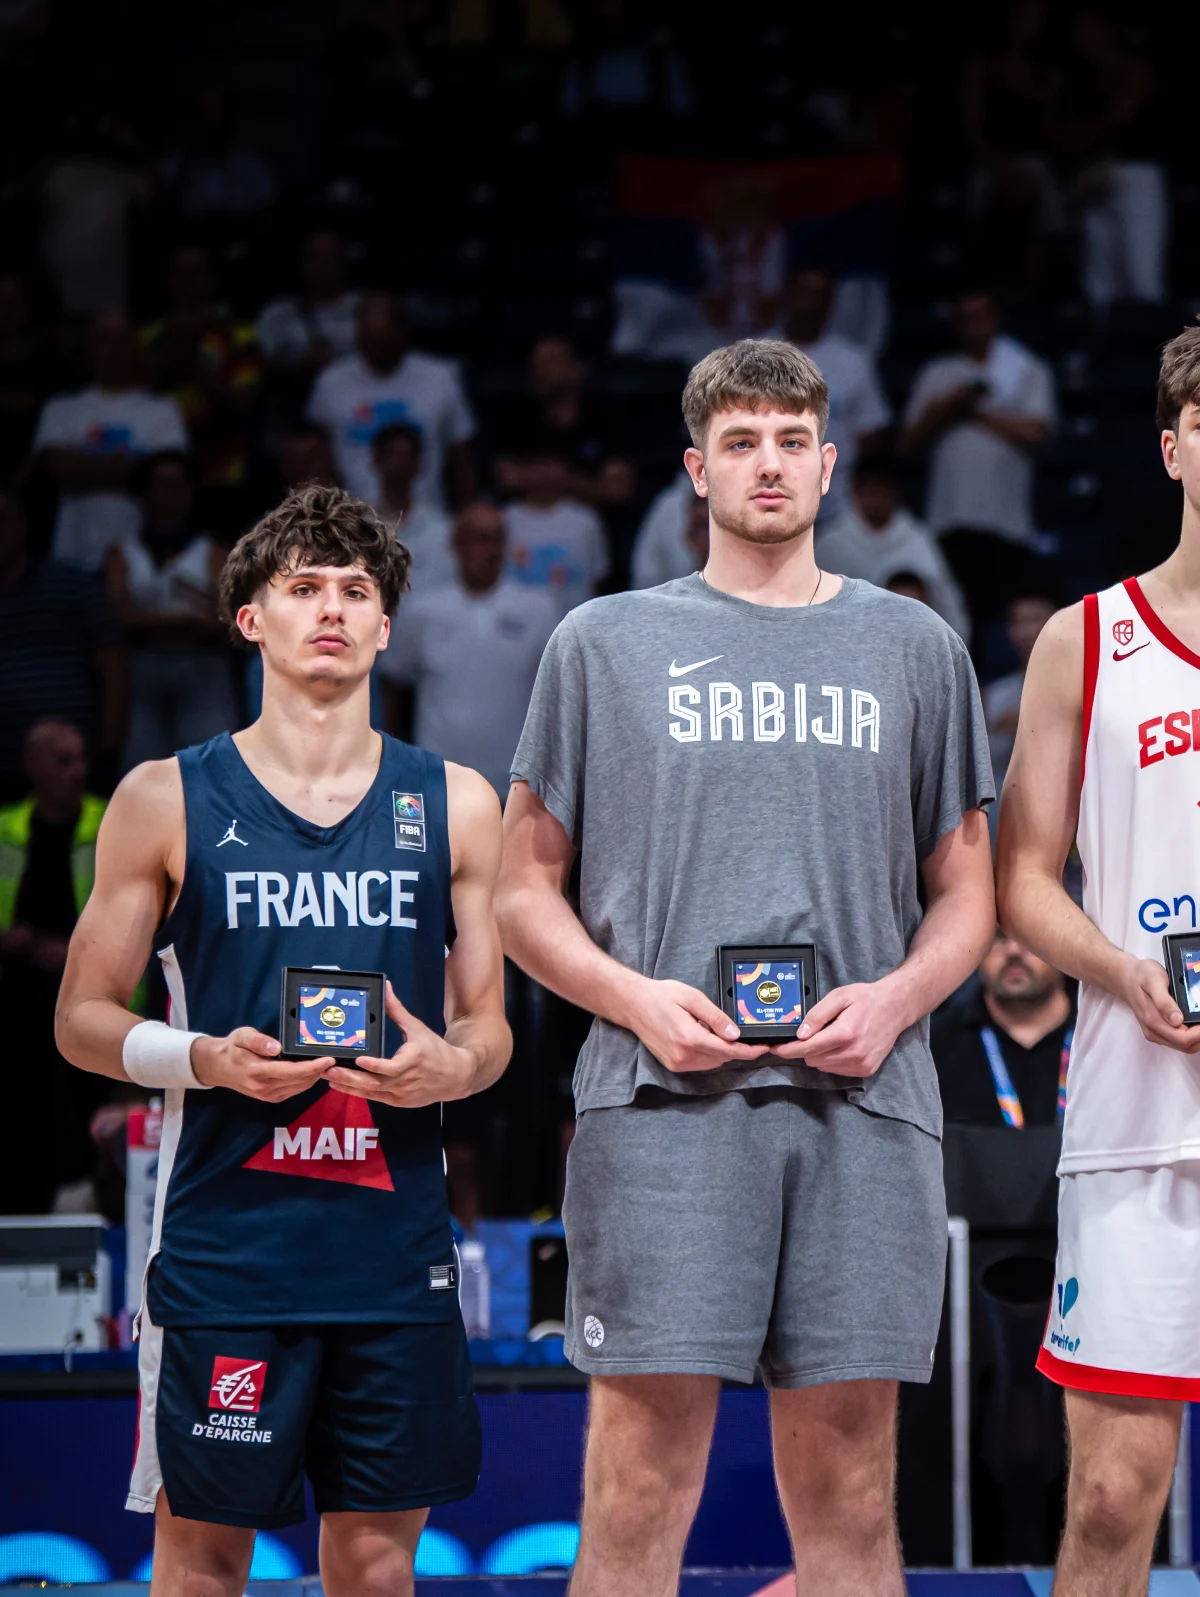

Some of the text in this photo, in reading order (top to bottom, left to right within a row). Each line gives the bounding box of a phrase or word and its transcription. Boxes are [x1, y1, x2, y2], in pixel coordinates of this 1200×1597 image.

[668, 681, 881, 754] SRBIJA
[399, 824, 421, 836] FIBA
[223, 870, 420, 930] FRANCE
[273, 1127, 380, 1161] MAIF
[192, 1423, 272, 1443] D'EPARGNE
[208, 1413, 257, 1429] CAISSE
